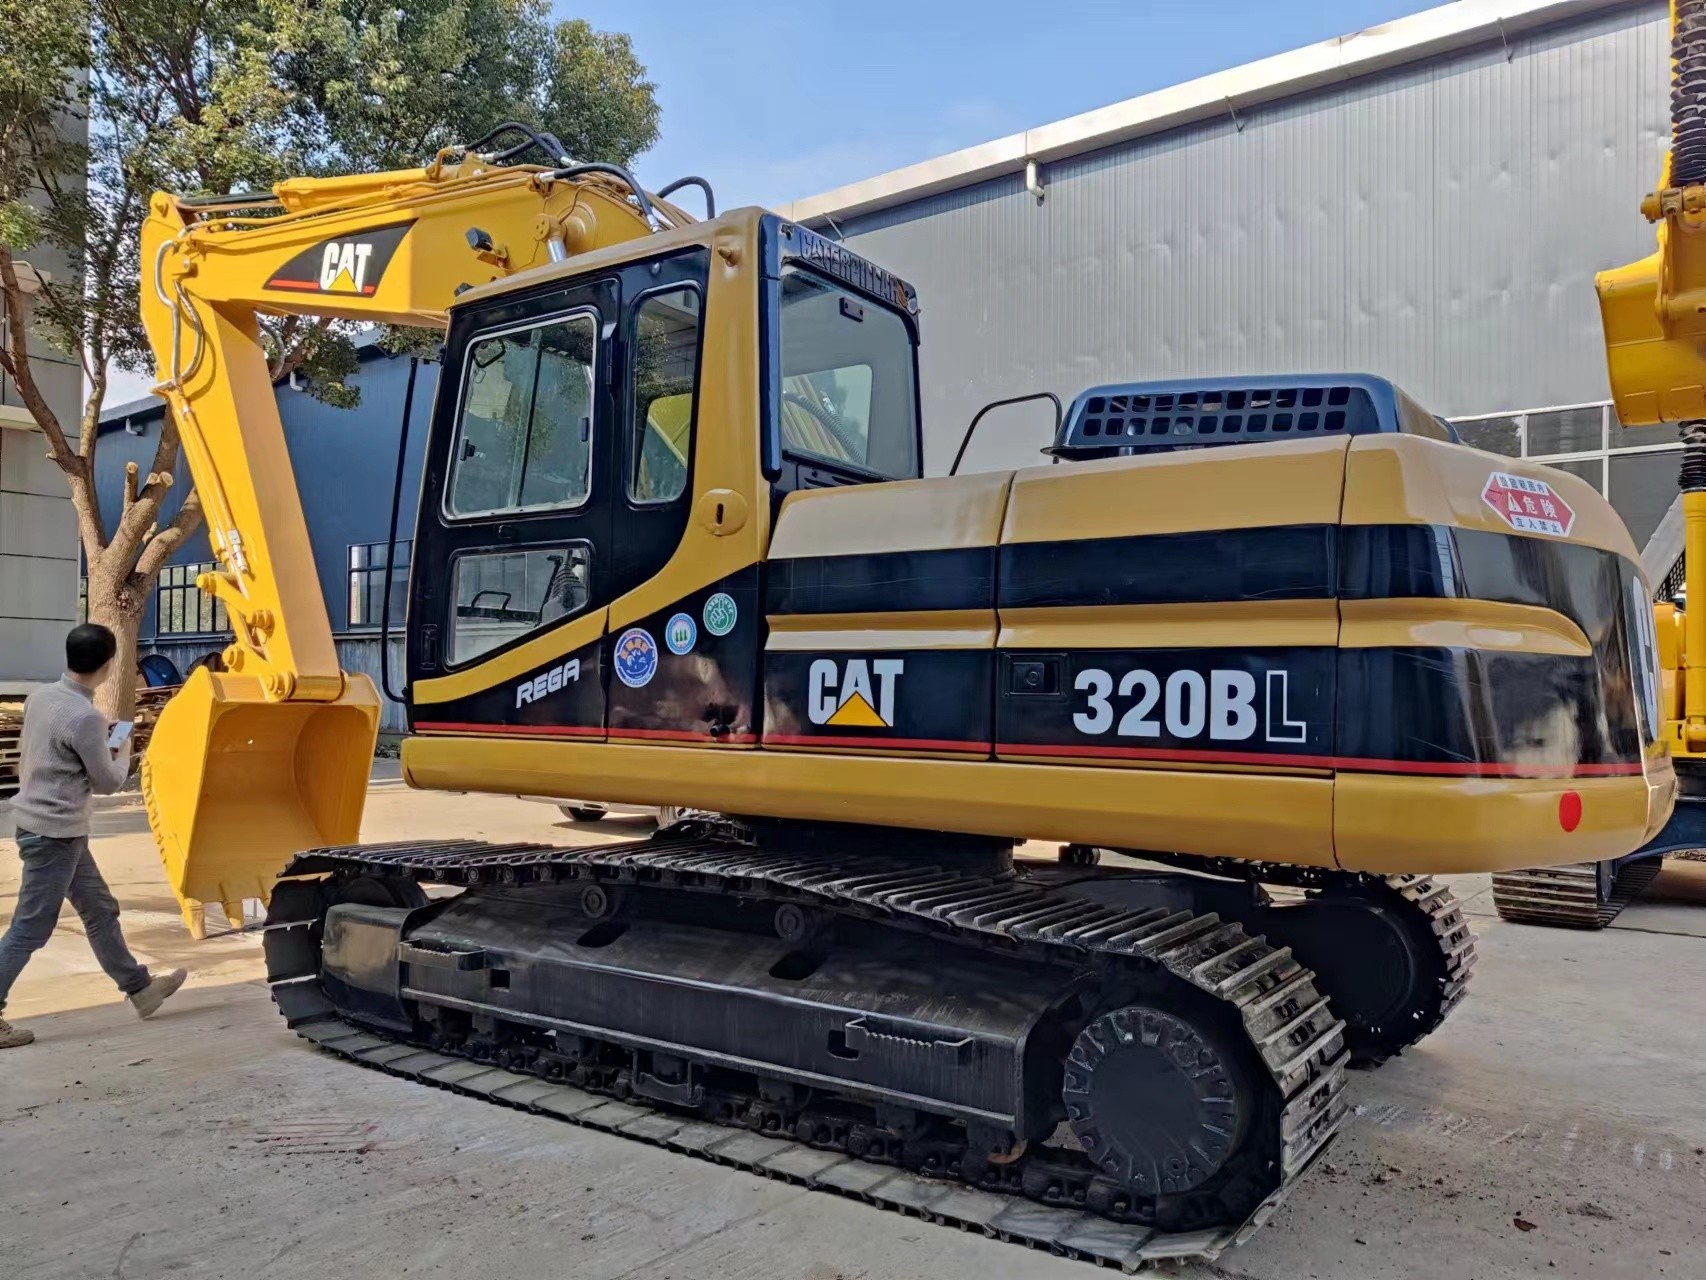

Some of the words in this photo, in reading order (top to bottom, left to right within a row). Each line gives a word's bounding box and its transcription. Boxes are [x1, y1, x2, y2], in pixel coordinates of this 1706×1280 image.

[320, 242, 372, 293] CAT
[1515, 517, 1560, 534] 立入禁止
[516, 658, 580, 709] REGA
[808, 658, 905, 728] CAT
